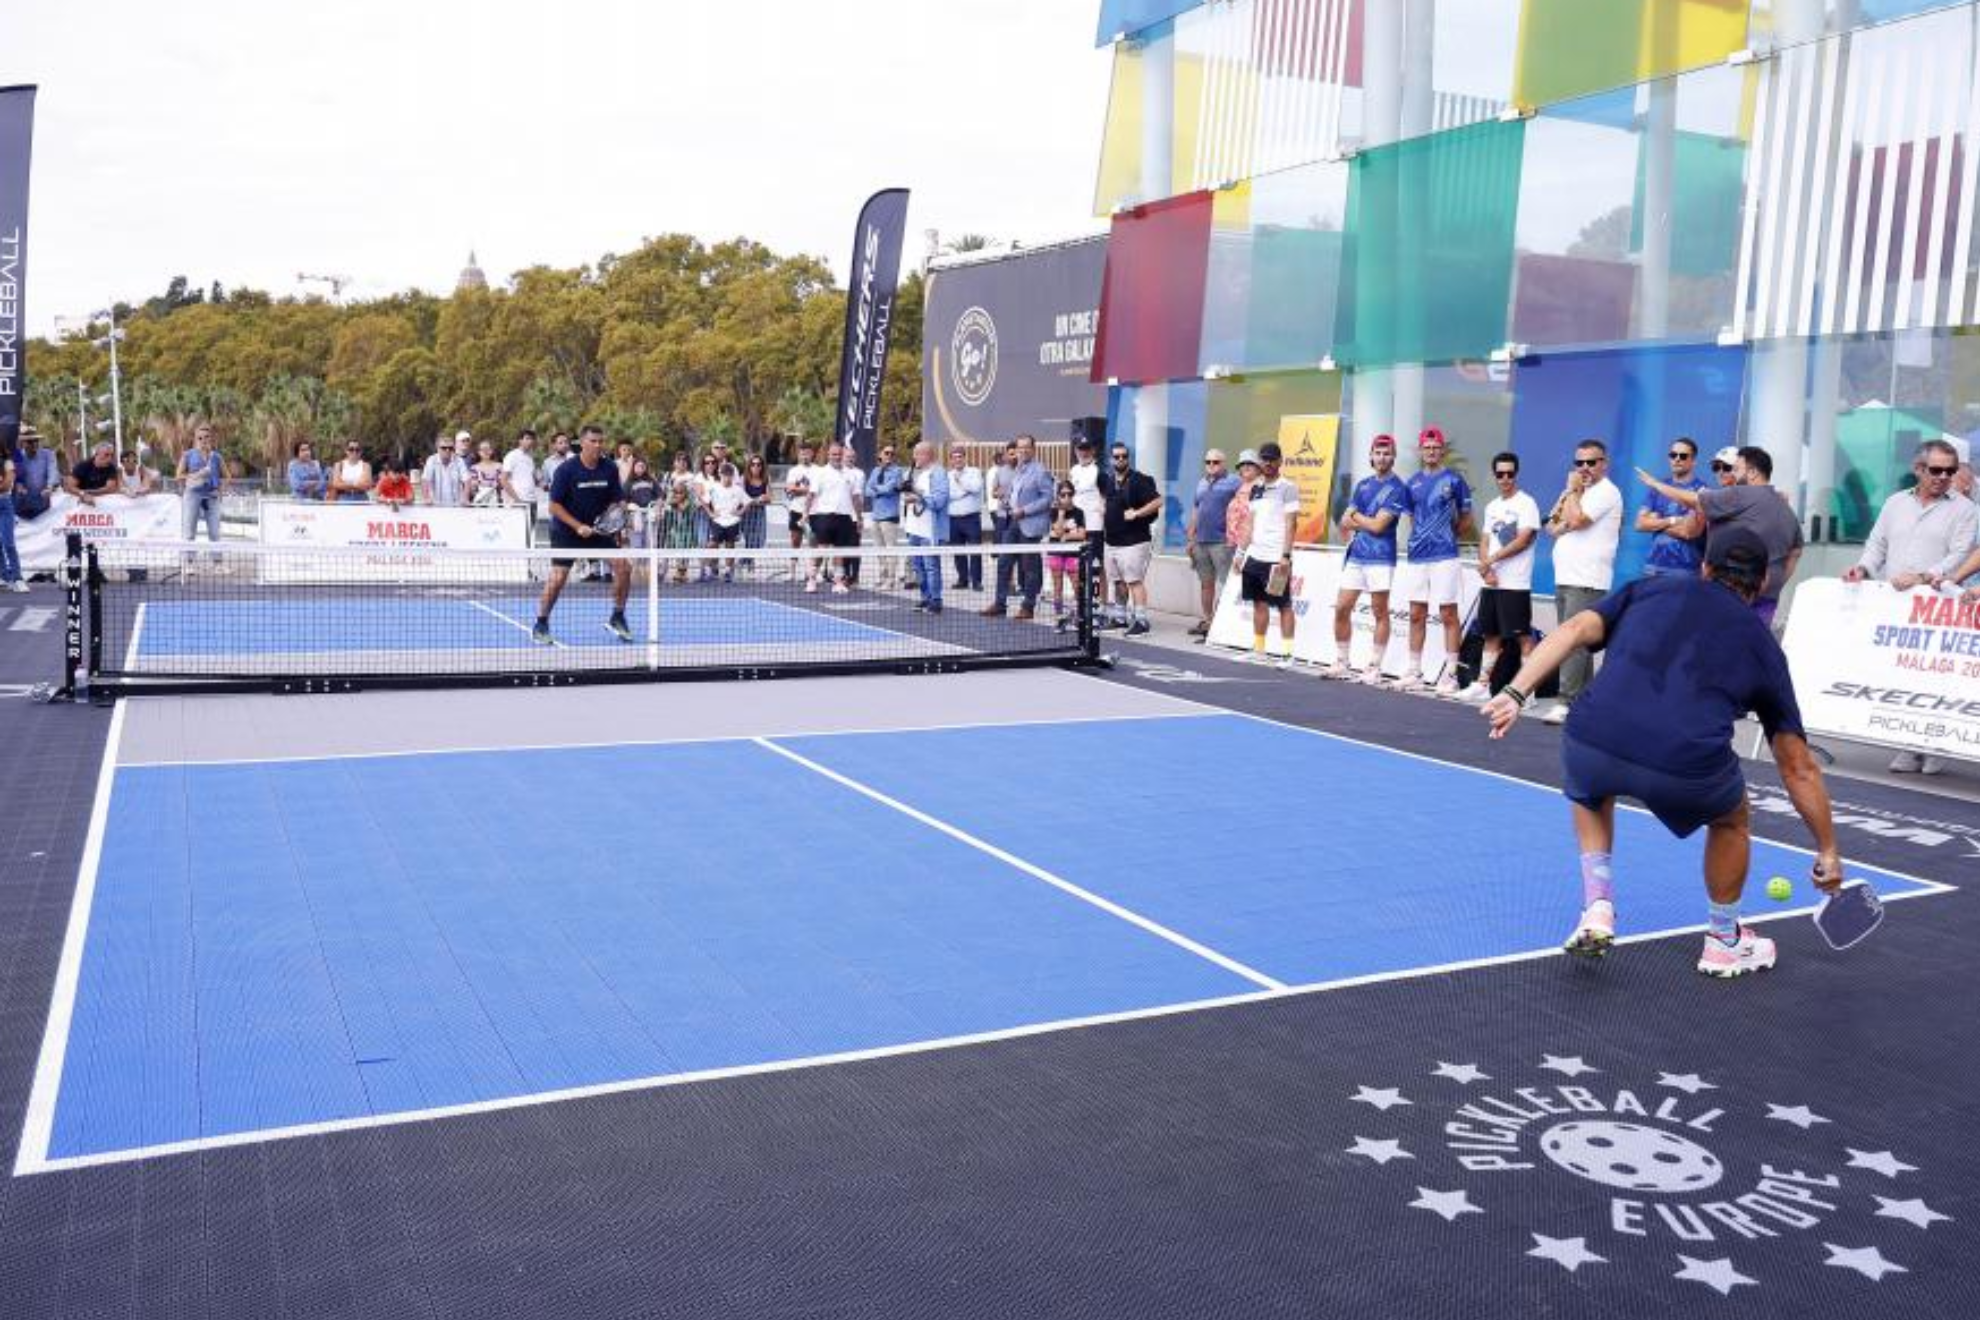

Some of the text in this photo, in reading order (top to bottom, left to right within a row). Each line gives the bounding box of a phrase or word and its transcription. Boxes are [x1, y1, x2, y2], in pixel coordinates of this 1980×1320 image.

[0, 227, 19, 396] PICKLEBALL
[862, 297, 892, 430] PICKLEBALL
[65, 513, 115, 527] MARCA
[366, 521, 432, 540] MARCA
[67, 578, 80, 658] WINNER
[1873, 625, 1980, 658] SPORT WEE
[1445, 1085, 1725, 1172] PICKLEBALL
[1610, 1163, 1841, 1241] EUROPE
